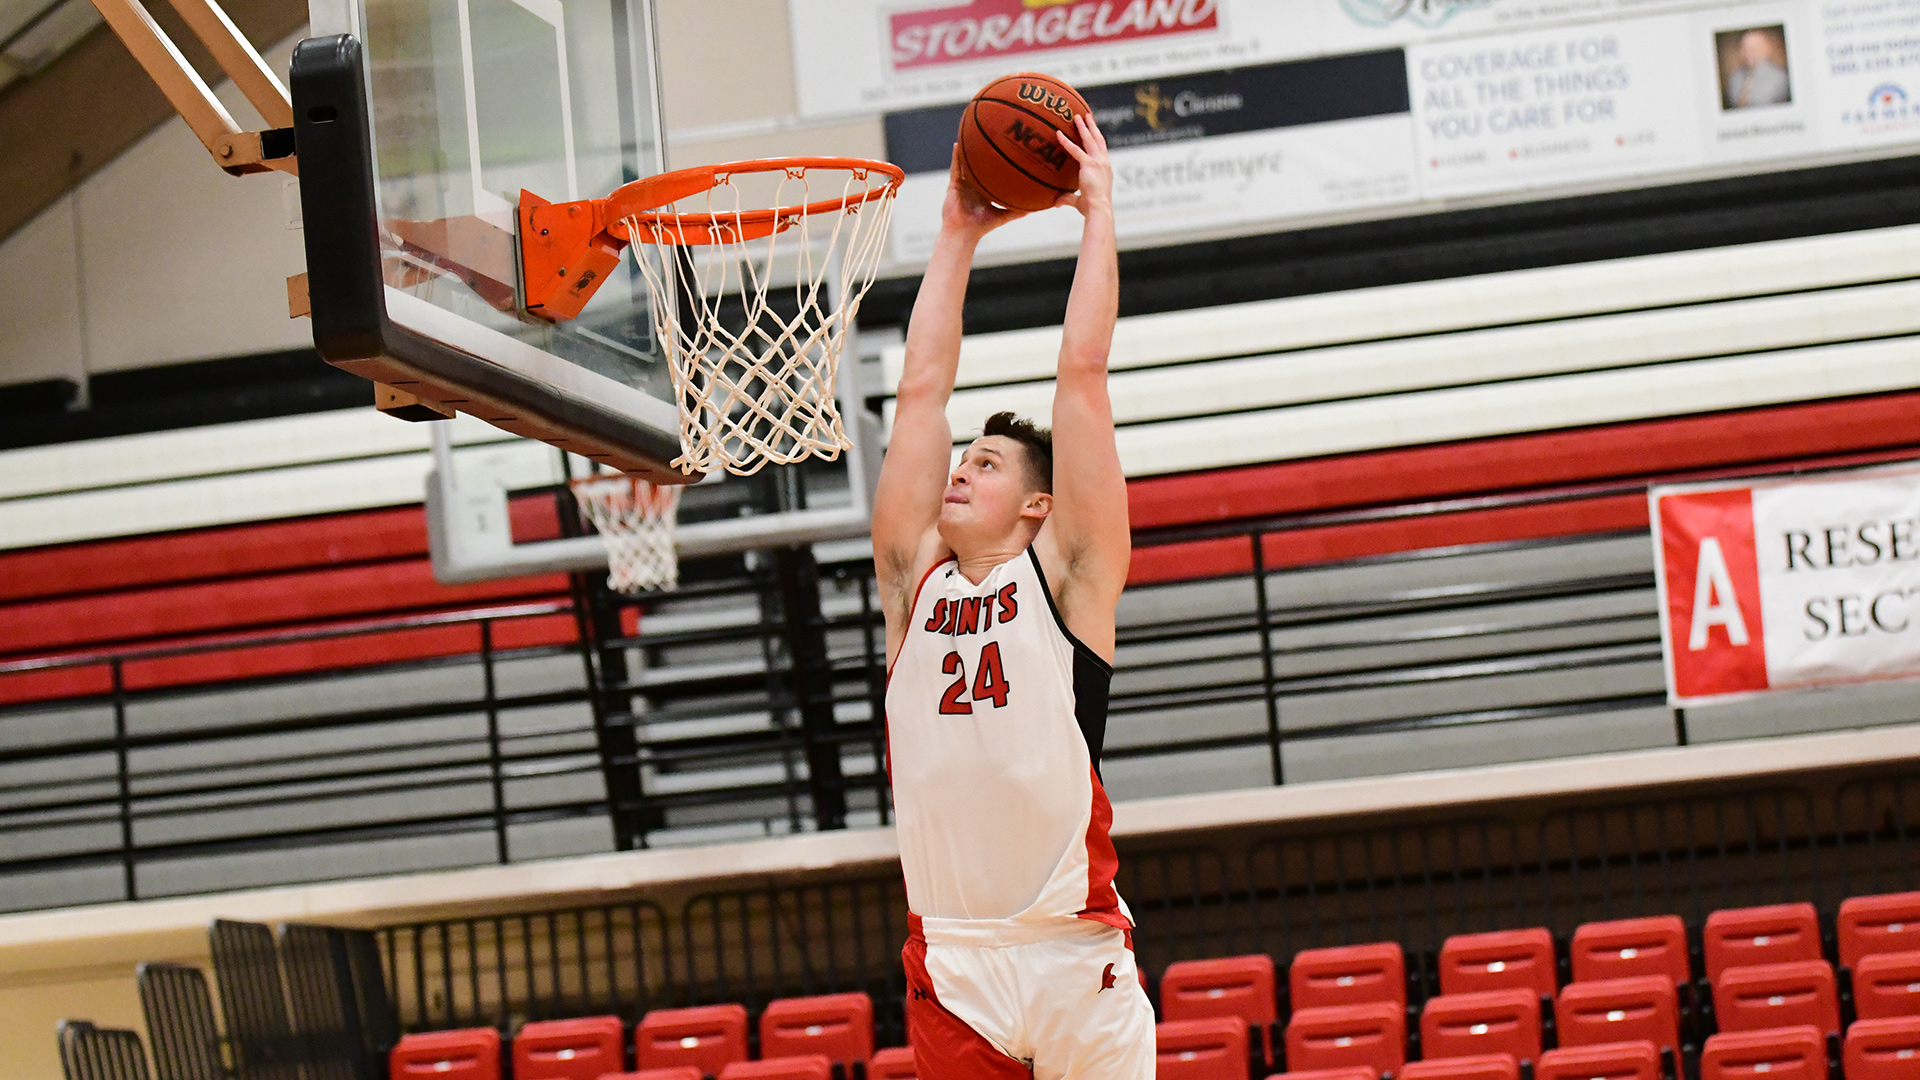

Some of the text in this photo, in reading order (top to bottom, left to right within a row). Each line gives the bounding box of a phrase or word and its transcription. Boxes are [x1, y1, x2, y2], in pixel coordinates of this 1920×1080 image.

[895, 0, 1217, 63] STORAGELAND
[1420, 35, 1620, 82] COVERAGE FOR
[1017, 83, 1075, 122] Wils
[1423, 63, 1631, 111] ALL THE THINGS
[1426, 94, 1617, 141] YOU CARE FOR
[1841, 103, 1920, 125] FARMER
[1006, 118, 1069, 172] NCAA
[924, 581, 1018, 638] SINTS
[1688, 536, 1750, 651] A
[938, 640, 1010, 715] 24
